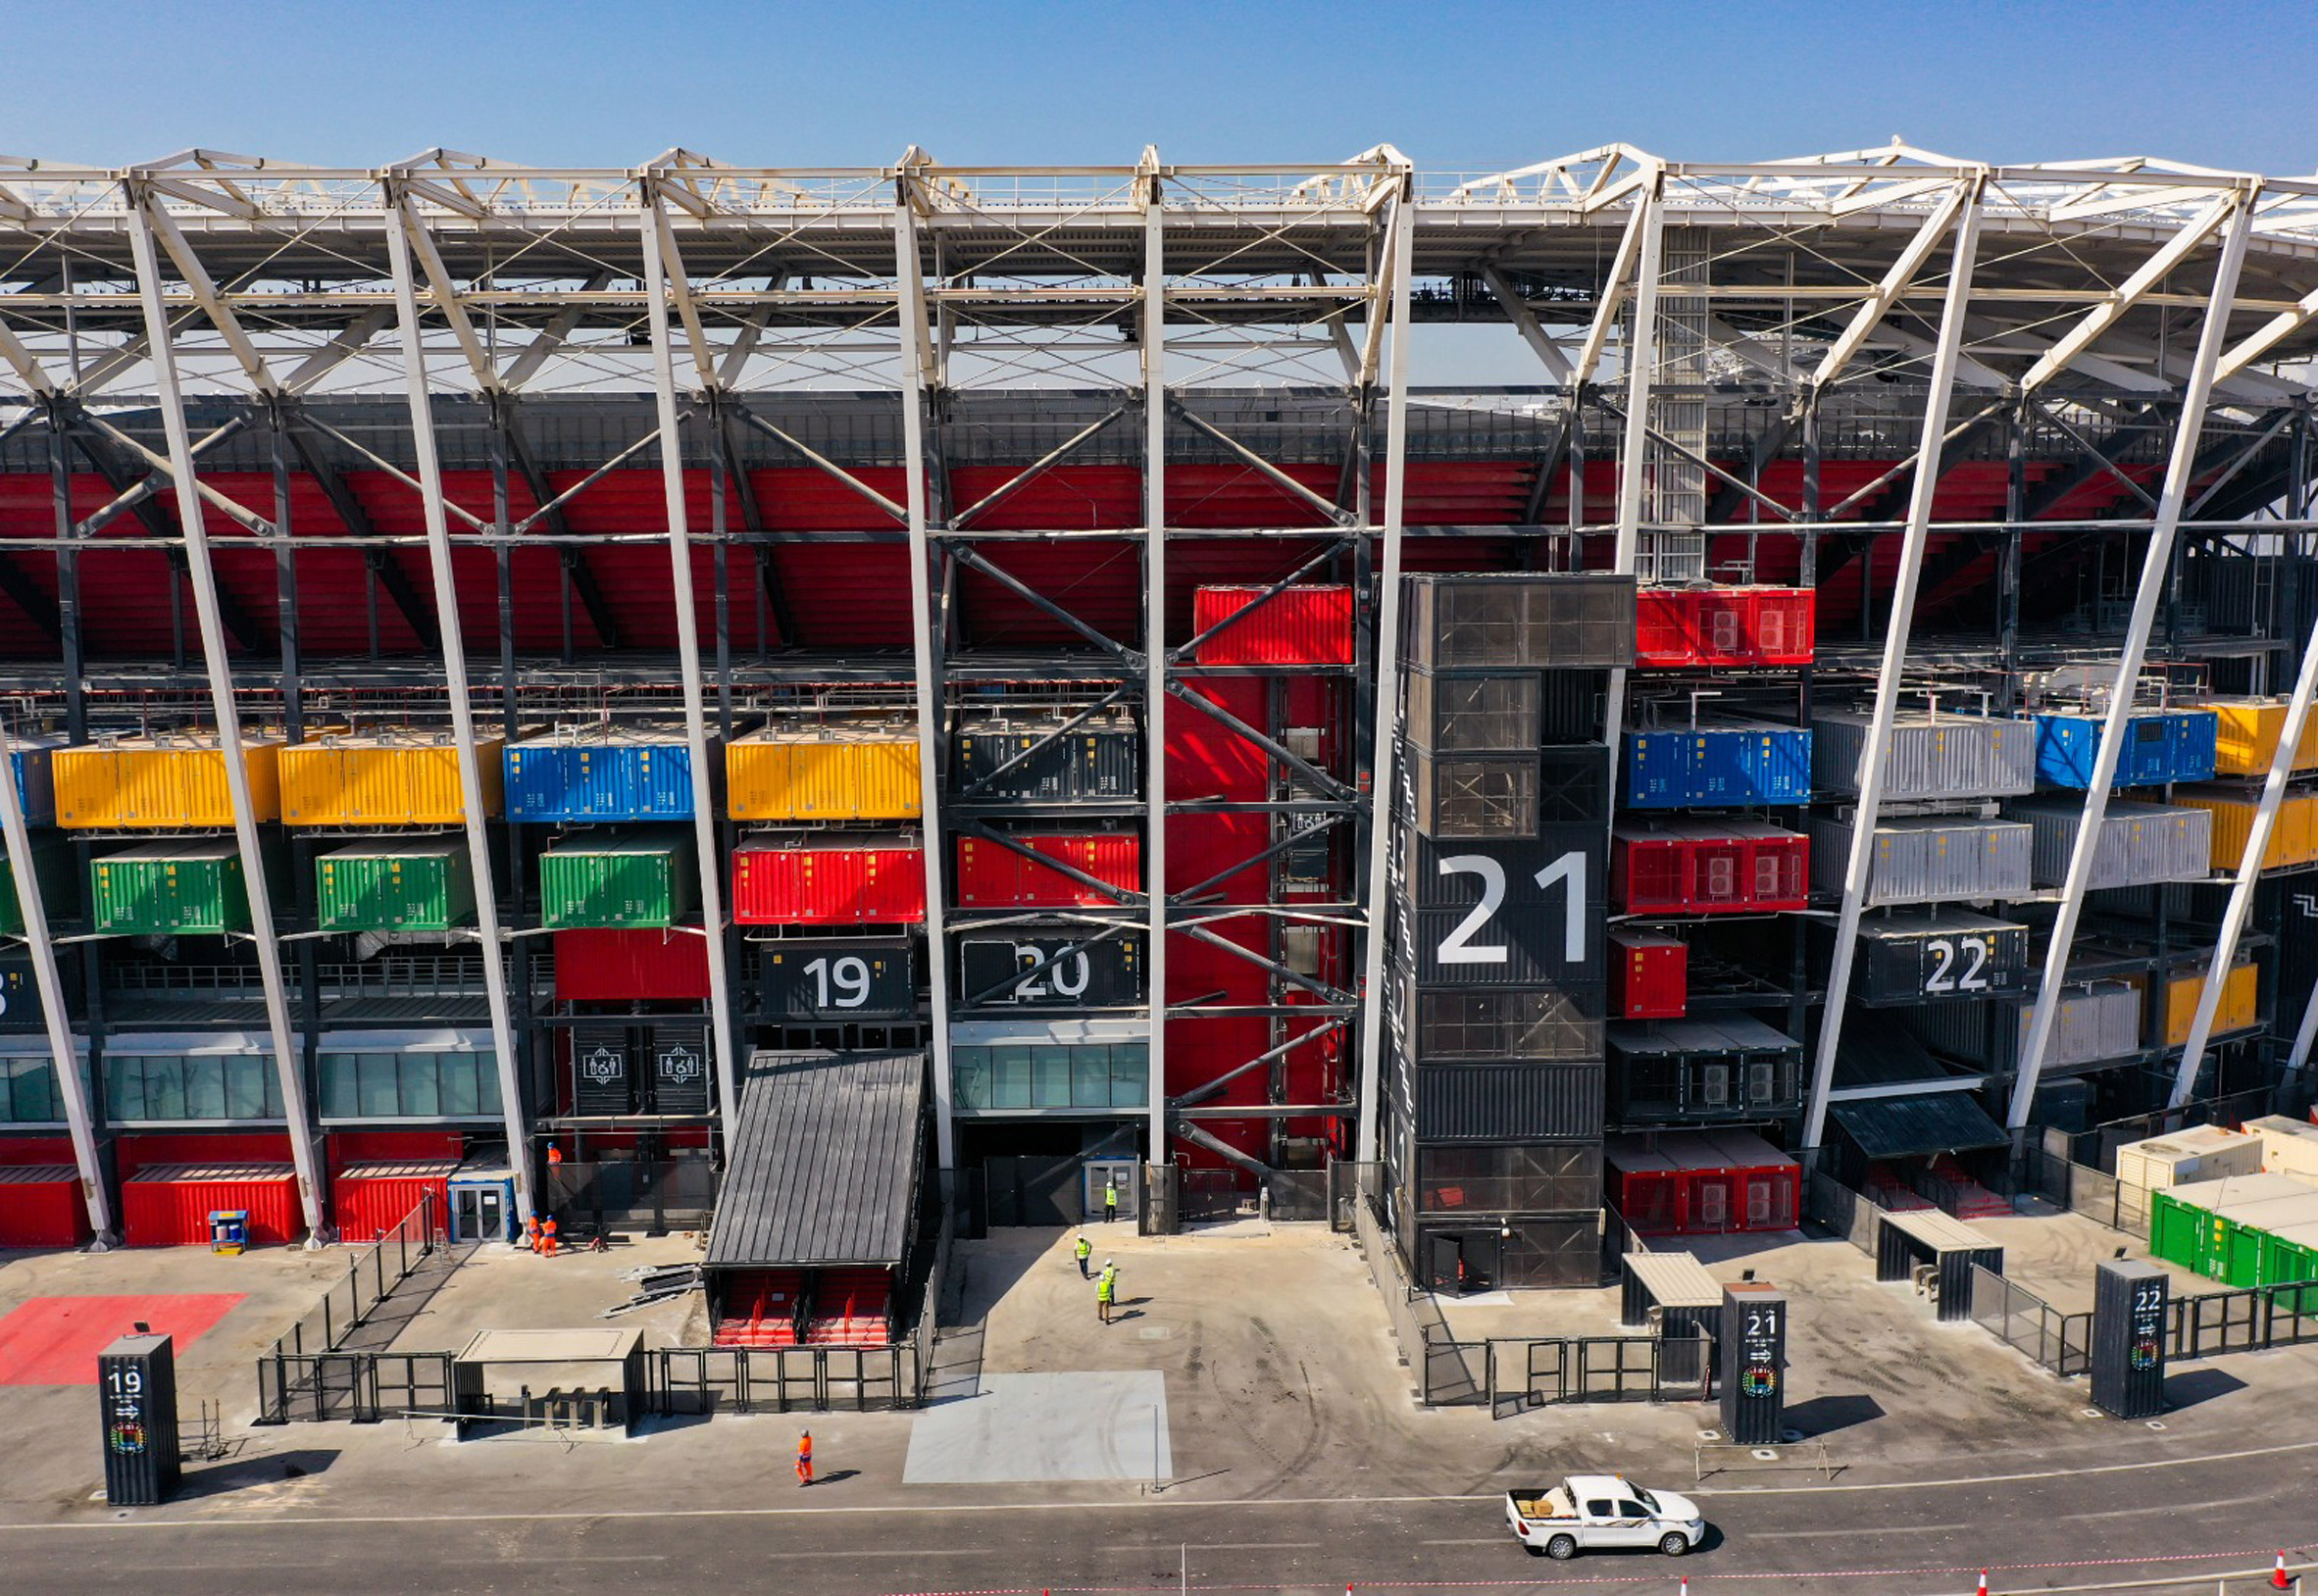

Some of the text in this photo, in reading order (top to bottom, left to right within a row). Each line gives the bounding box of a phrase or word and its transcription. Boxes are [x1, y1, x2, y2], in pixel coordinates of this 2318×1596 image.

[1437, 852, 1587, 966] 21
[803, 957, 871, 1008] 19
[1016, 946, 1090, 997] 20
[1926, 938, 1988, 992] 22
[1747, 1315, 1776, 1336] 21
[2135, 1290, 2161, 1312] 22
[108, 1372, 141, 1393] 19
